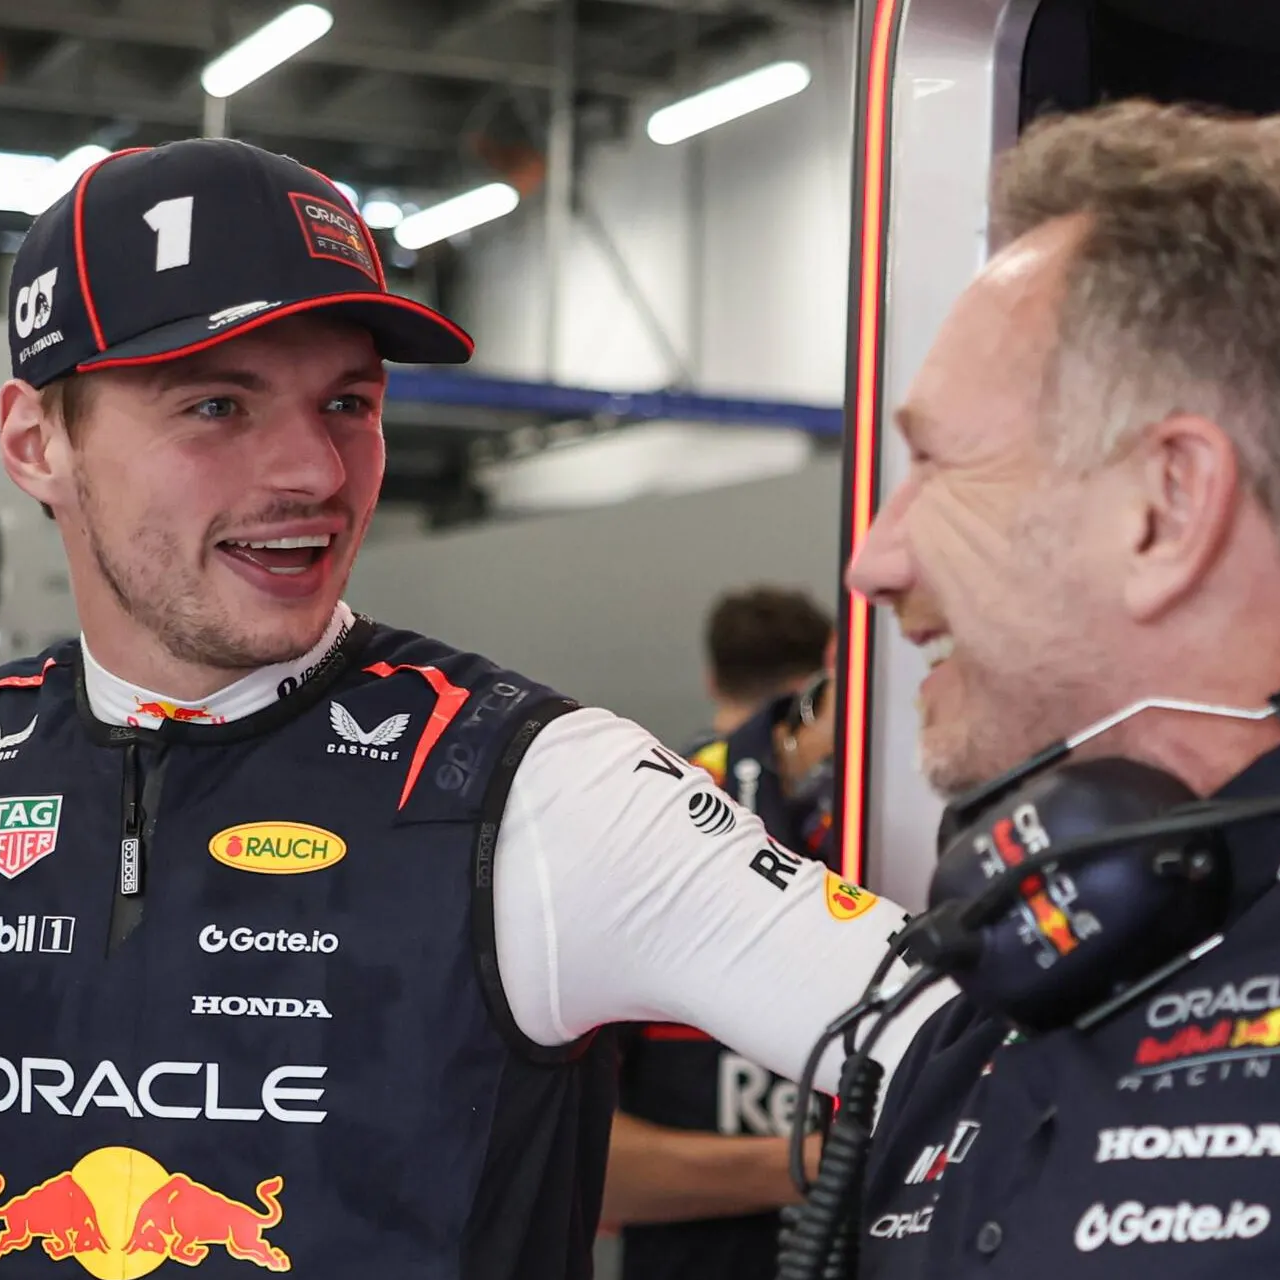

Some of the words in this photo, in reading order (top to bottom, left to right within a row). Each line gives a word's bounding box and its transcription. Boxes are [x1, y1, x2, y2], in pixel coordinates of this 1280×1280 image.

[142, 196, 194, 272] 1
[305, 204, 360, 239] ORACLE
[327, 743, 399, 761] CASTORE
[245, 836, 328, 859] RAUCH
[123, 841, 137, 894] sparco
[230, 927, 339, 953] Gate.io
[191, 995, 332, 1018] HONDA
[1108, 1200, 1271, 1246] Gate.io
